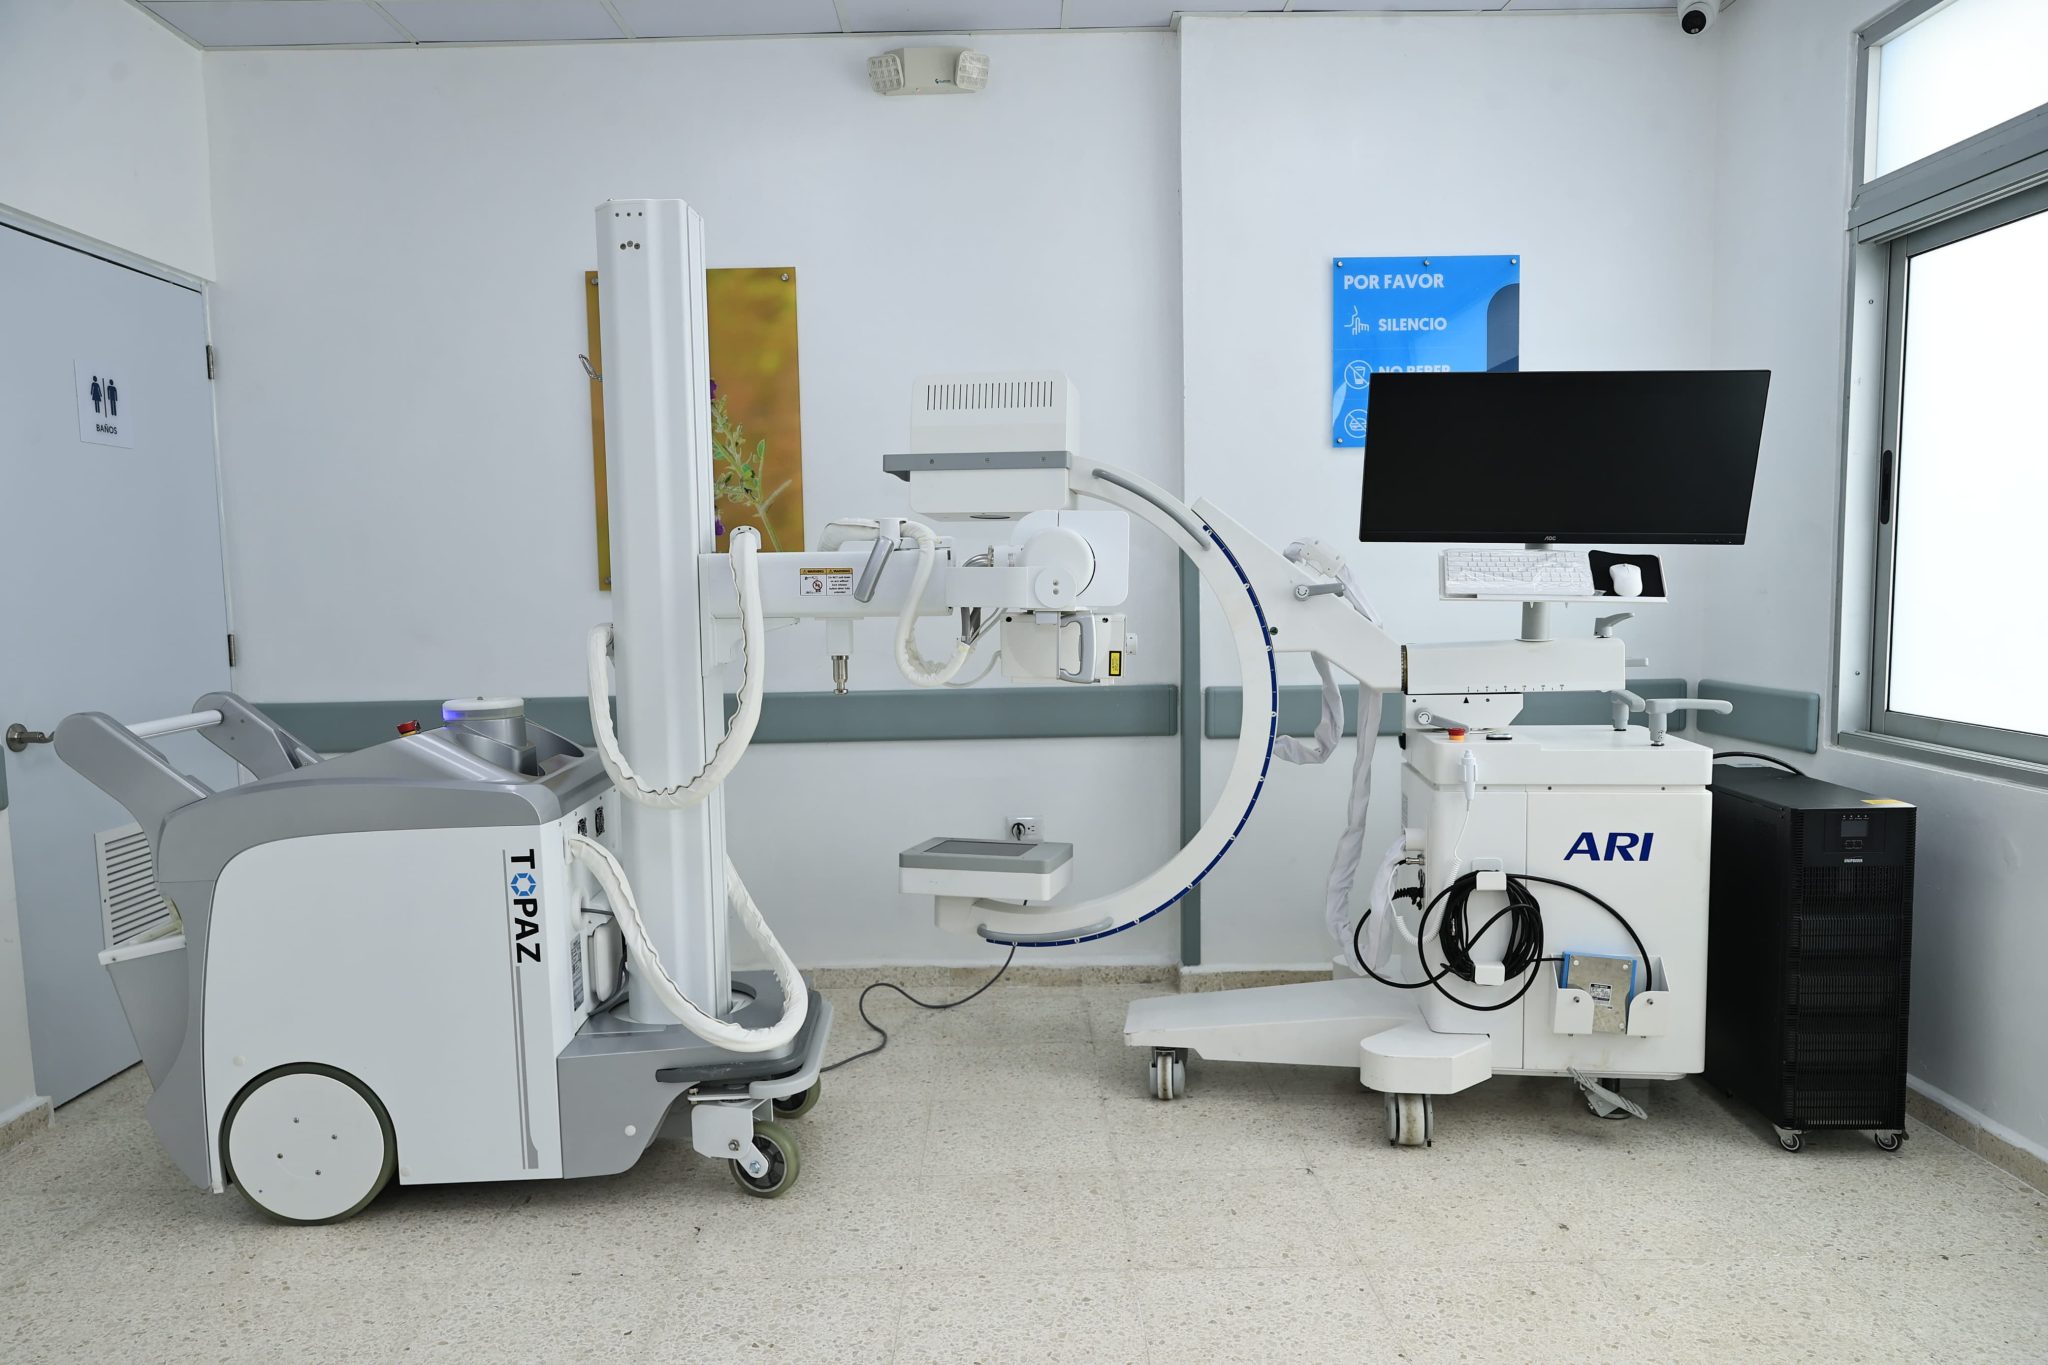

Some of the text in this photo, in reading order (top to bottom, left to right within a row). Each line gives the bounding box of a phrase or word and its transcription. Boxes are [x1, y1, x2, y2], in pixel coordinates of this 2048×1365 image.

[1343, 273, 1445, 290] POR FAVOR
[1378, 317, 1448, 332] SILENCIO
[96, 423, 118, 435] BAÑOS
[1563, 831, 1654, 862] ARI
[510, 848, 541, 964] TOPAZ
